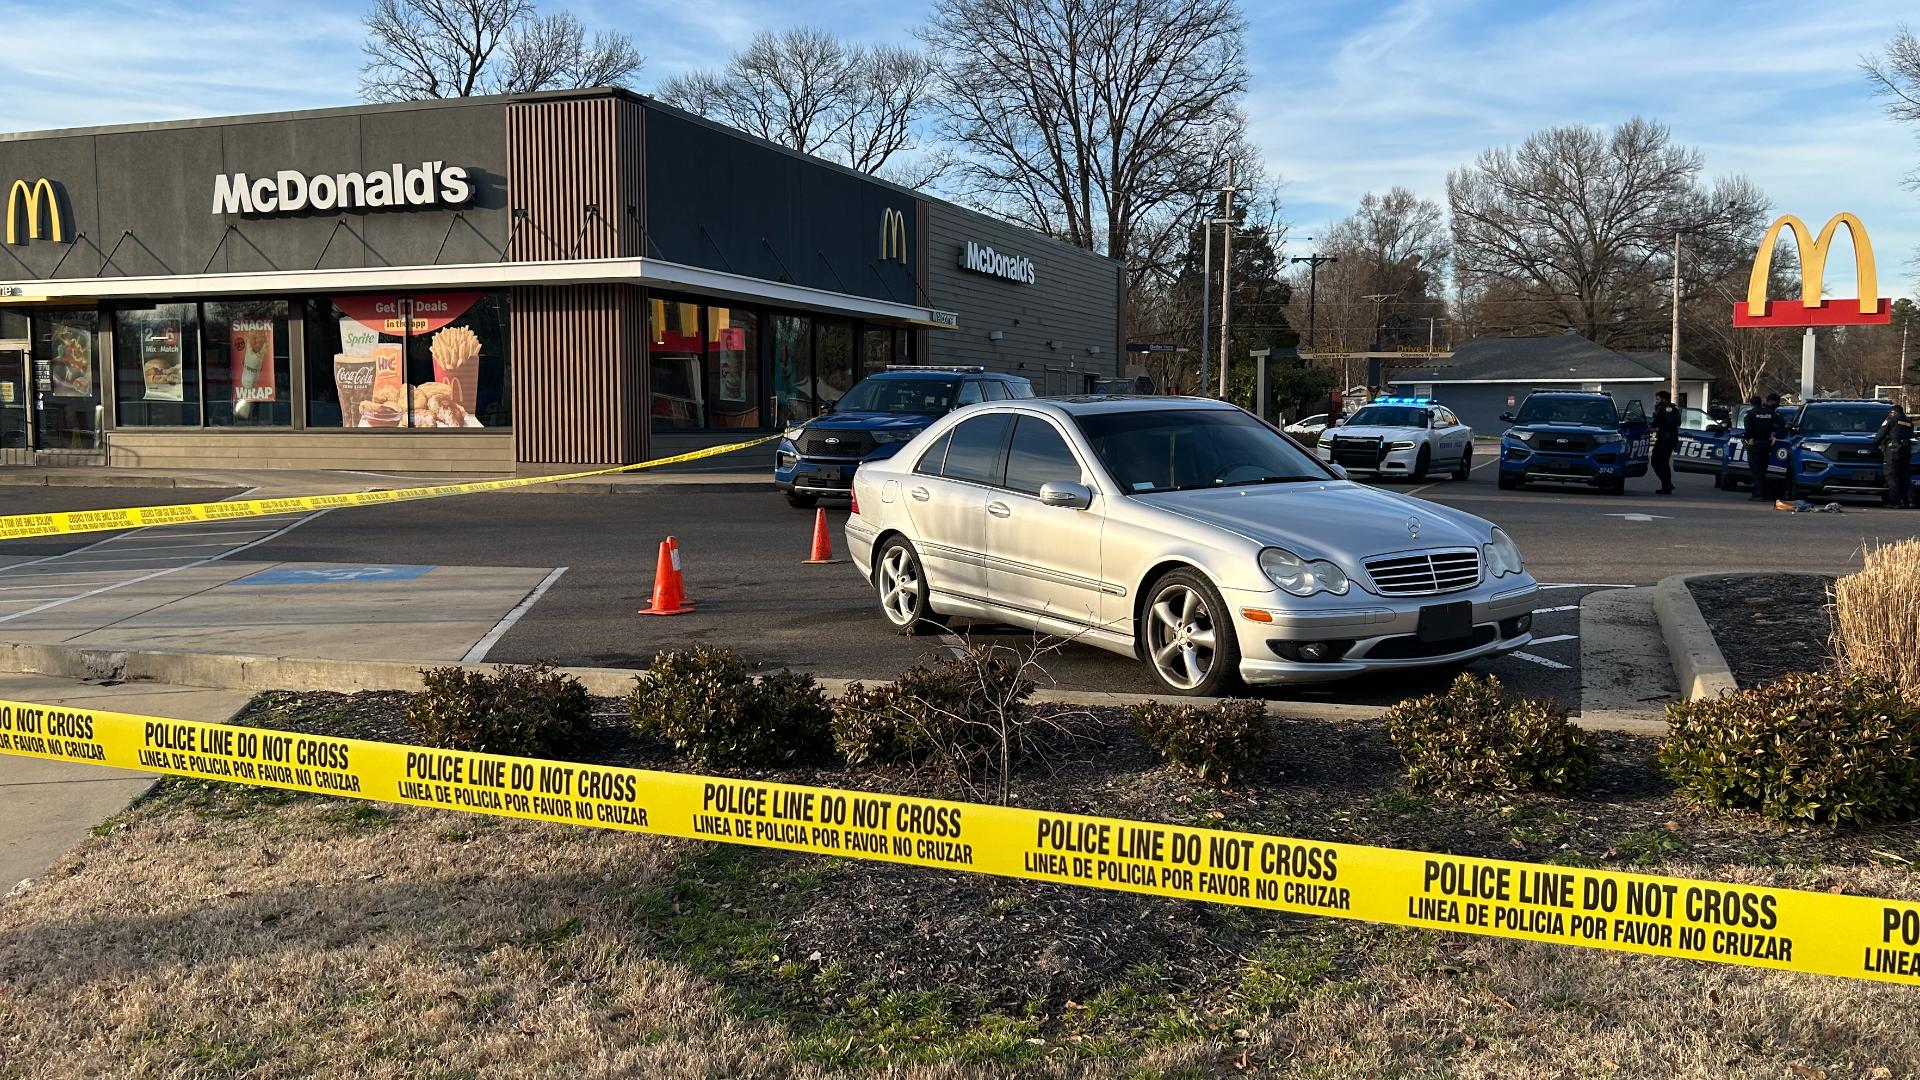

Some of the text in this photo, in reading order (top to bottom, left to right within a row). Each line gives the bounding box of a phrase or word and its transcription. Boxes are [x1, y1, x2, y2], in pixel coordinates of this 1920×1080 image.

[211, 160, 470, 215] McDonald's
[966, 240, 1036, 286] McDonald's
[232, 320, 272, 332] SNACK
[375, 300, 448, 313] Get Deals
[386, 319, 395, 328] in
[145, 345, 157, 353] Mix
[160, 345, 179, 353] Match
[346, 332, 375, 347] Sprite
[1396, 344, 1421, 352] Drive
[235, 386, 273, 400] WRAP
[0, 707, 94, 740] O NOT CROSS
[145, 722, 349, 770] POLICE LINE DO NOT CROSS
[12, 734, 47, 754] FAVOR
[47, 738, 64, 756] NO
[64, 740, 106, 761] CRUZAR
[138, 749, 361, 793] LINEA DE POLICIA POR FAVOR NO CRUZAR
[406, 751, 637, 803] POLICE LINE DO NOT CROSS
[398, 780, 649, 827] LINEA DE POLICIA POR FAVOR NO CRUZAR
[703, 783, 961, 839] POLICE LINE DO NOT CROSS
[693, 814, 973, 865] LINEA DE POLICIA POR FAVOR NO CRUZAR
[1037, 818, 1337, 882] POLICE LINE DO NOT CROSS
[1024, 851, 1350, 910] LINEA DE POLICIA POR FAVOR NO CRUZAR
[1424, 860, 1777, 930] POLICE LINE DO NOT CROSS
[1408, 896, 1793, 962] LINEA DE POLICIA POR FAVOR NO CRUZAR
[1864, 947, 1920, 977] LINEA
